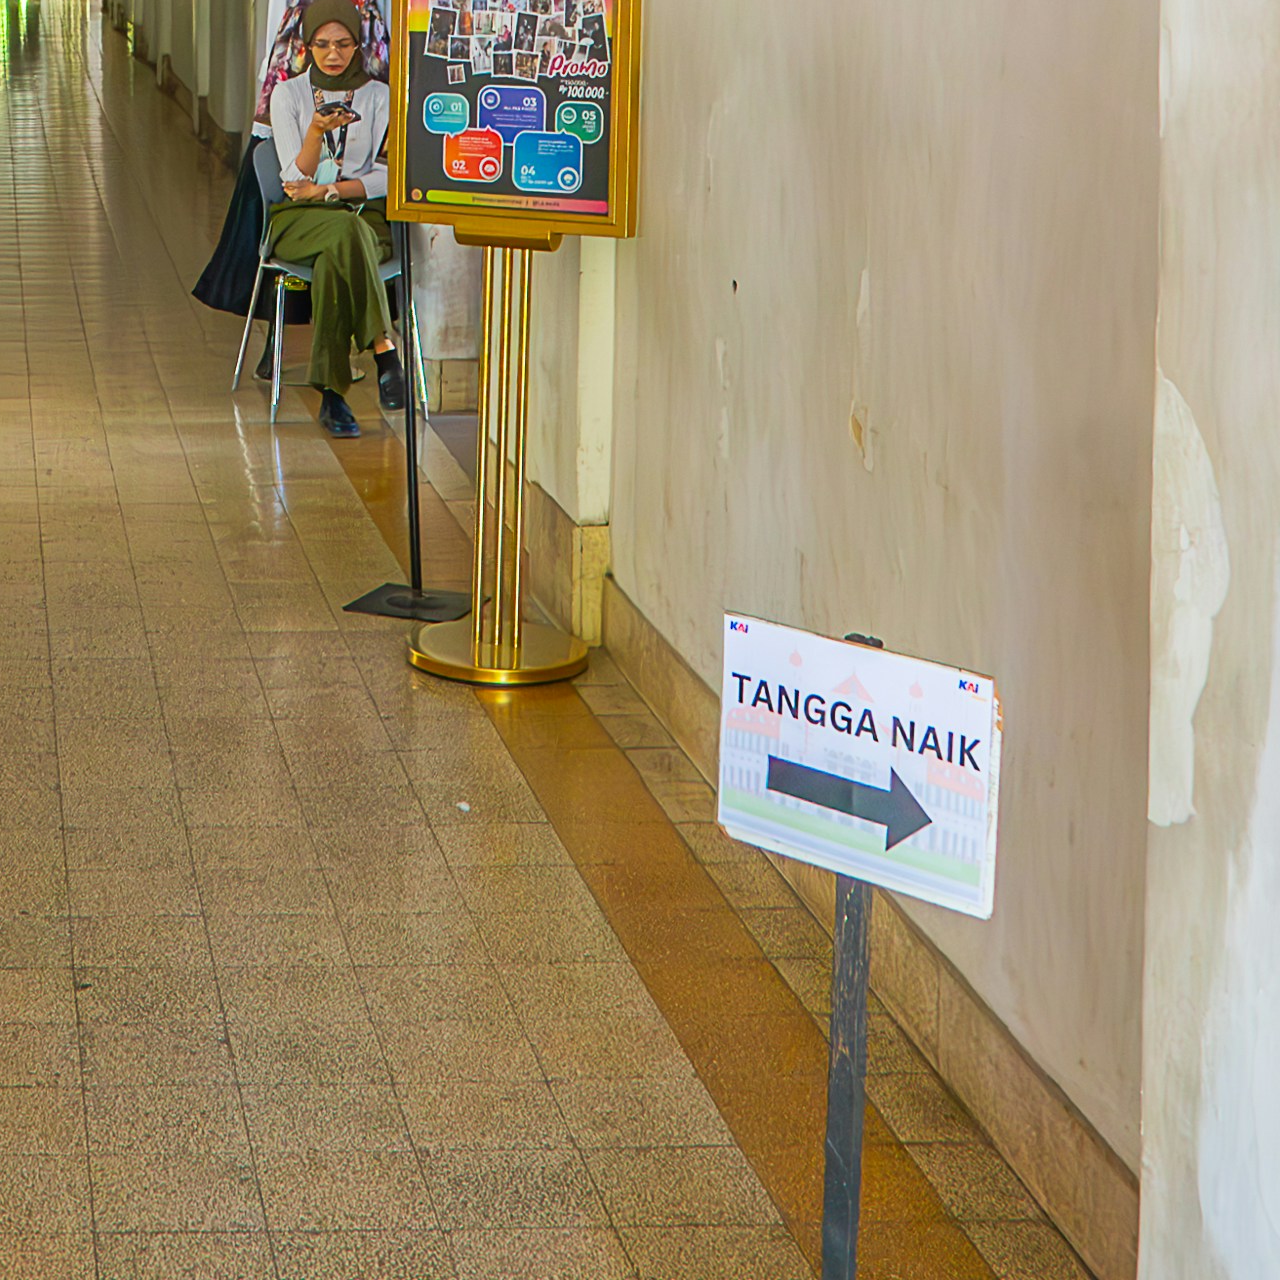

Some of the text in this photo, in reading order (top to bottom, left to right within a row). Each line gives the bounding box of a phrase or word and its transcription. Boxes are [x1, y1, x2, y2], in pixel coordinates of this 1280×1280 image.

[548, 54, 608, 77] Promo
[450, 101, 463, 112] 01
[522, 96, 537, 107] 03
[582, 110, 597, 121] 05
[451, 159, 466, 170] 02
[520, 165, 536, 176] 04
[729, 620, 749, 635] KAI
[958, 679, 979, 694] KAI
[731, 671, 981, 773] TANGGA NAIK
